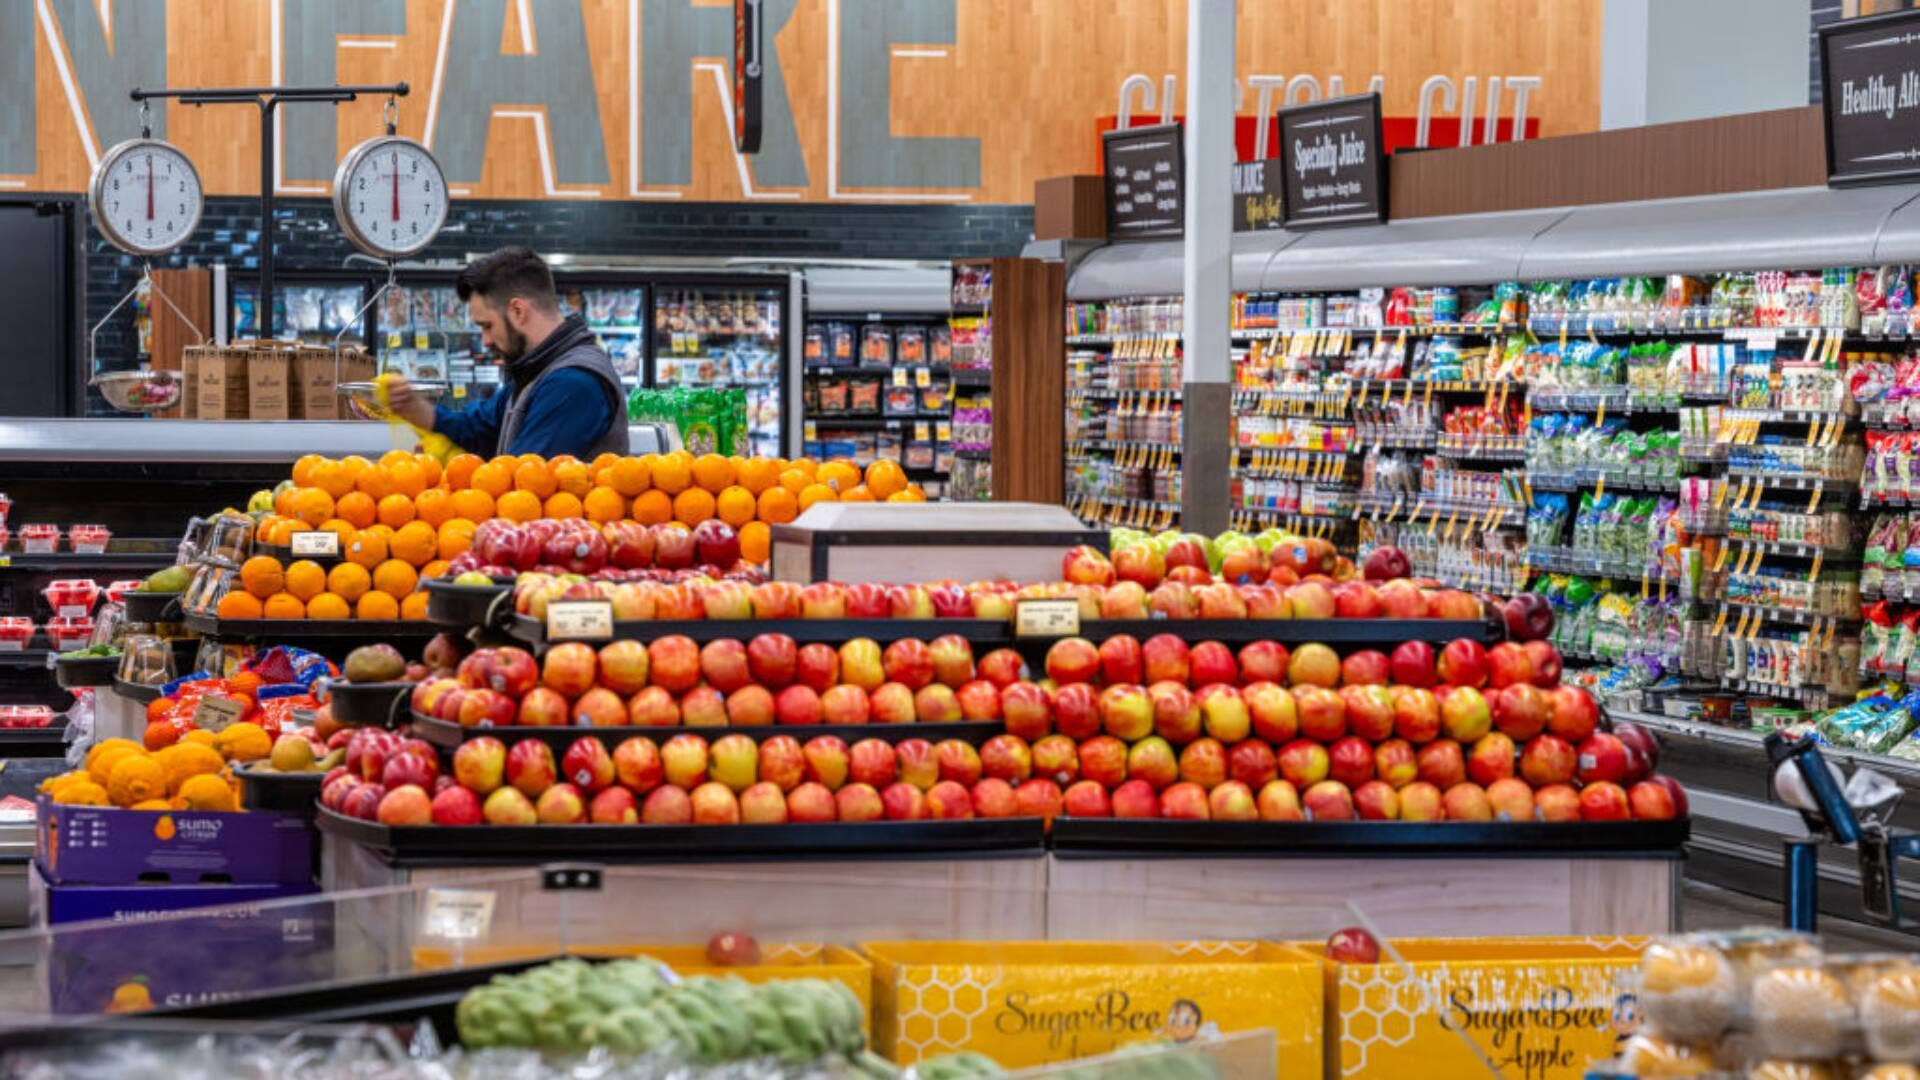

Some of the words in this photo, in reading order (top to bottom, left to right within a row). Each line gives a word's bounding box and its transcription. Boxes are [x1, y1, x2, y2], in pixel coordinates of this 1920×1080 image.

[1841, 75, 1896, 119] Healthy
[1295, 134, 1337, 180] Specialty
[1339, 131, 1366, 166] Juice
[995, 990, 1161, 1050] SugarBee
[1440, 987, 1607, 1048] SugarBee
[1487, 1033, 1576, 1080] Apple
